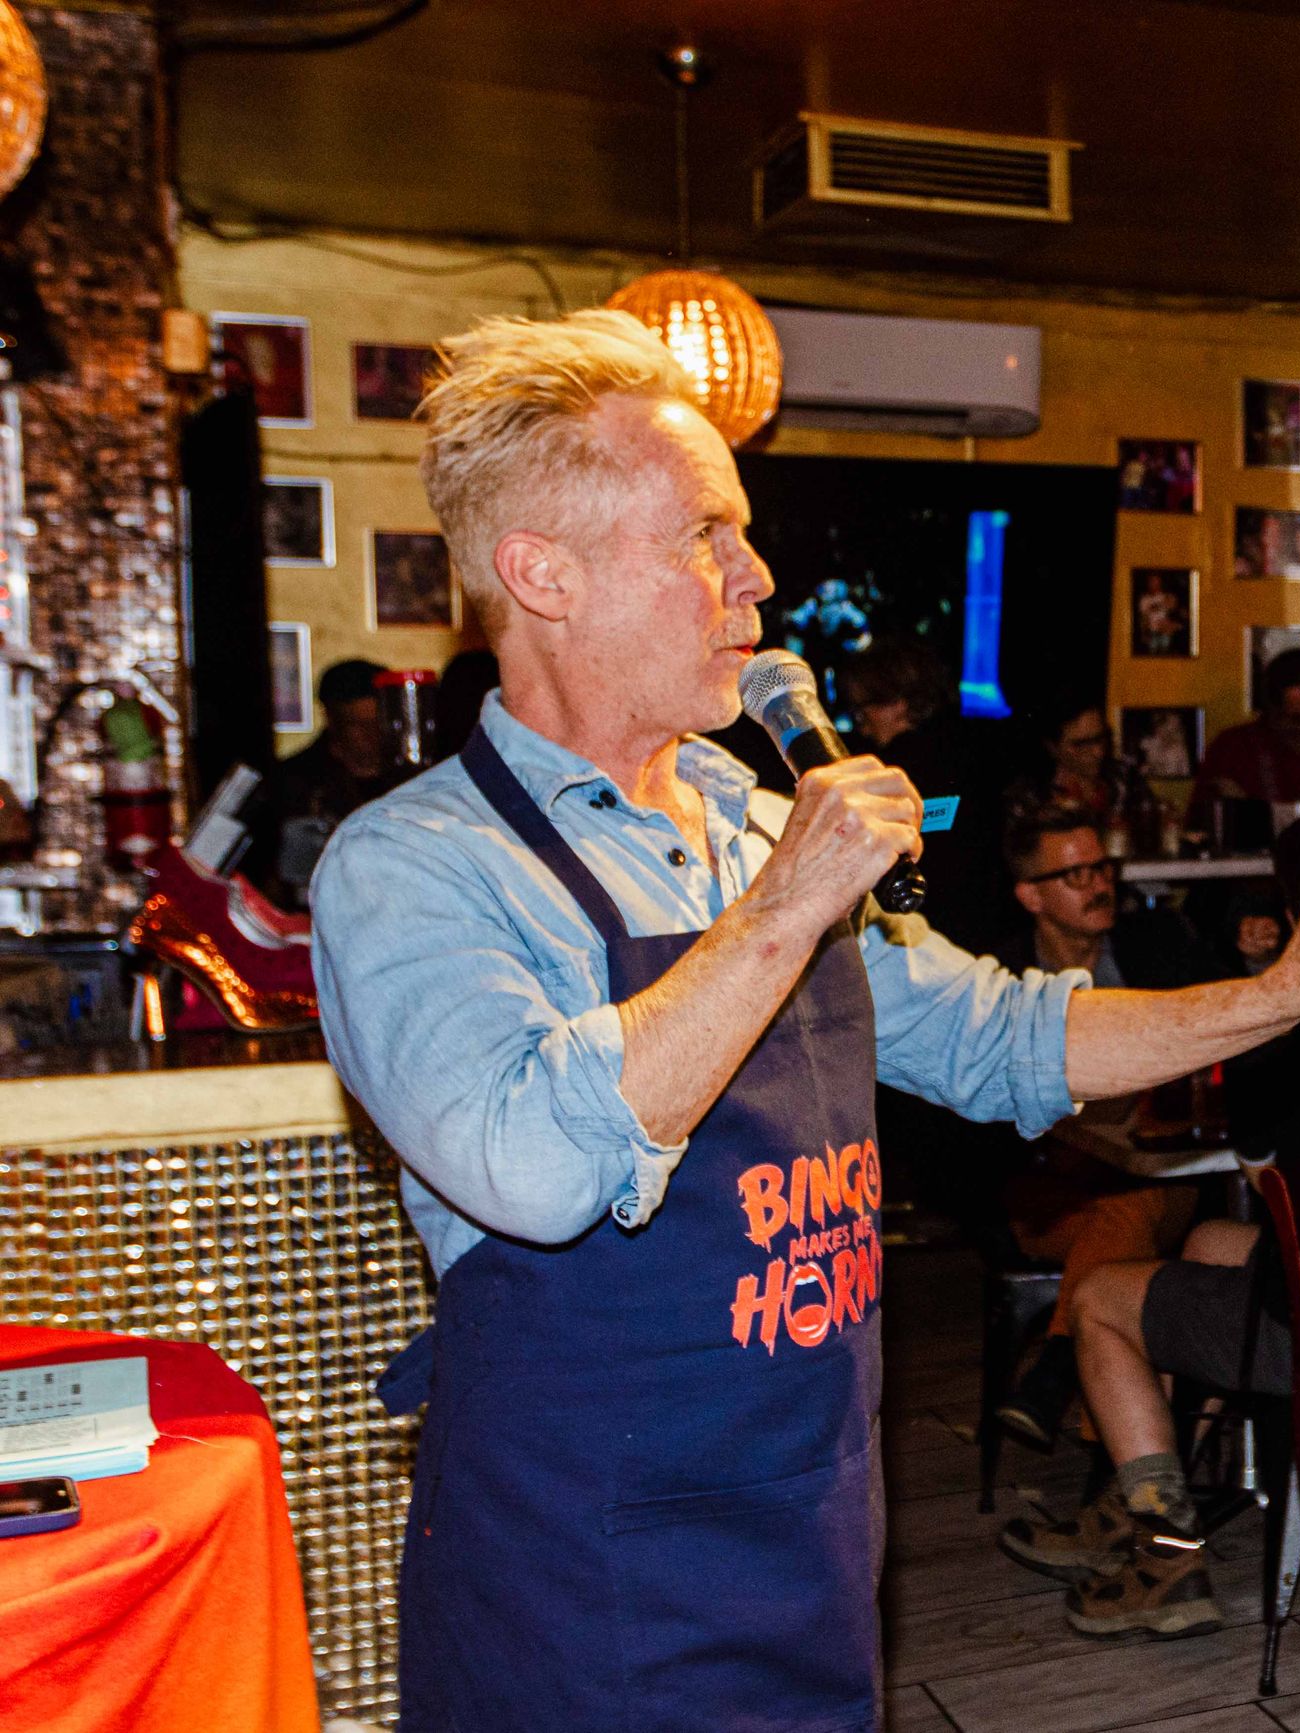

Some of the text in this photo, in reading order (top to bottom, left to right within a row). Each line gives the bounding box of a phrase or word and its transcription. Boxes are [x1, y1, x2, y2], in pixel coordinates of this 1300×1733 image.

[737, 1138, 882, 1254] BINGO
[789, 1215, 872, 1268] MAKES ME
